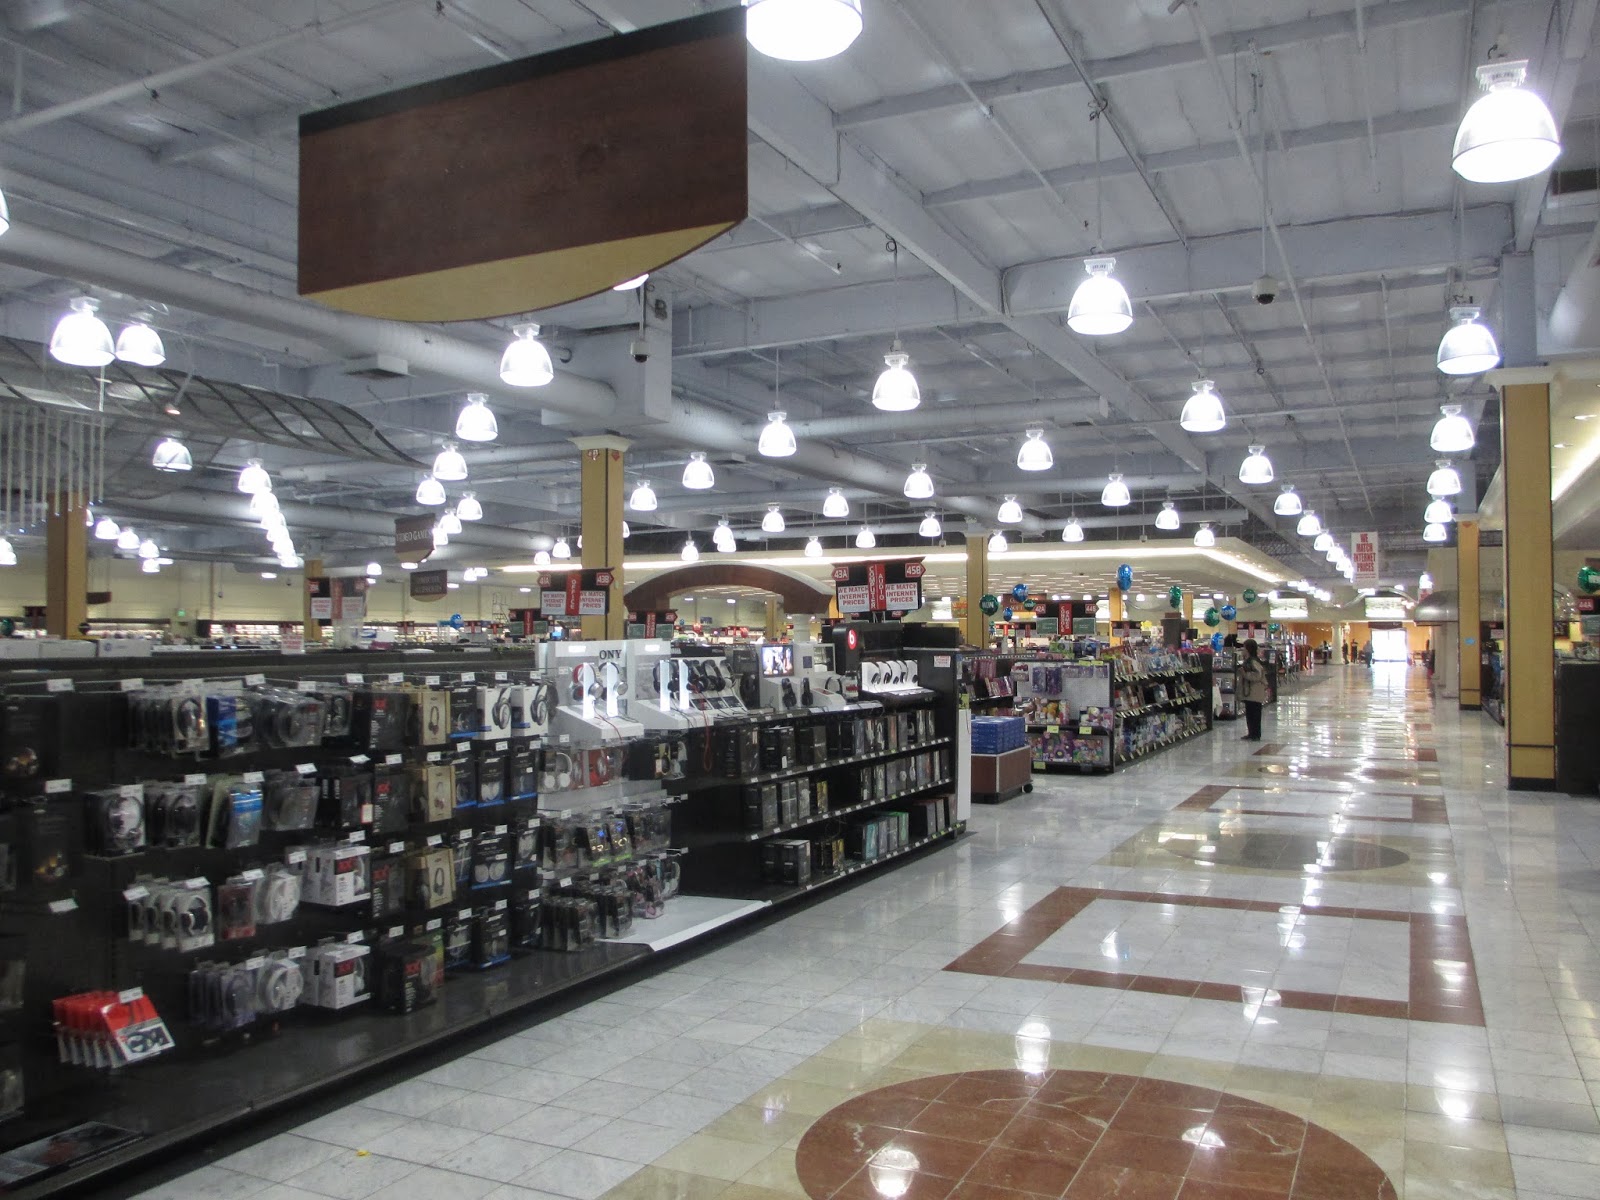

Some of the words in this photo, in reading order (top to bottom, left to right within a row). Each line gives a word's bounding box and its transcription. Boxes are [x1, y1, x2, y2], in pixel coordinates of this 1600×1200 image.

[1360, 533, 1368, 543] WE
[1356, 543, 1373, 552] MATCH
[1353, 552, 1376, 562] INTERNET
[906, 565, 921, 575] 45B
[1356, 562, 1374, 572] PRICES
[834, 569, 848, 579] 43A
[599, 649, 622, 660] ONY
